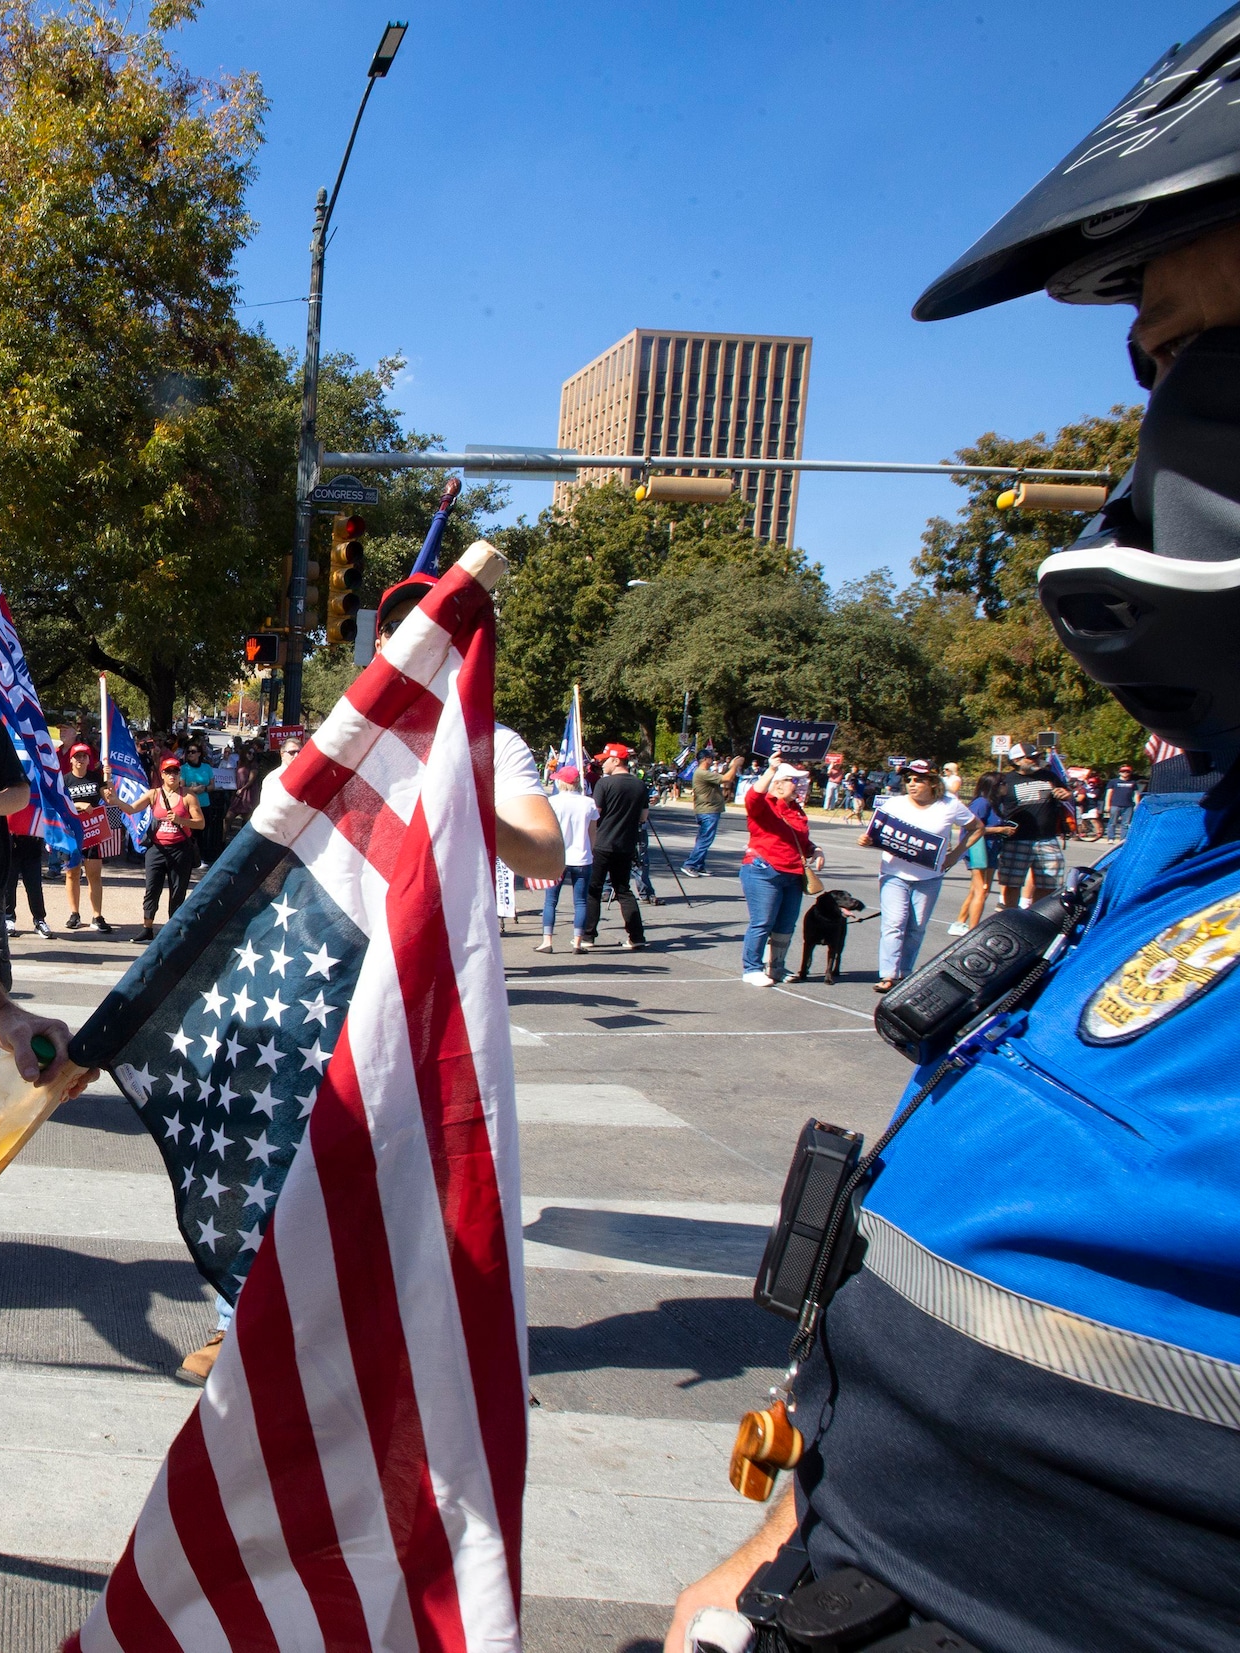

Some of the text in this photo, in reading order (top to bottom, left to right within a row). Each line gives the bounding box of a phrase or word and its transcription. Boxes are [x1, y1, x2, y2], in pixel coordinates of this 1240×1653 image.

[314, 488, 364, 500] CONGRESS
[270, 730, 303, 738] TRUMP
[760, 726, 830, 742] TRUMP
[771, 743, 810, 753] 2020
[110, 750, 137, 765] KEEP
[82, 814, 105, 828] UMP
[874, 819, 938, 851] TRUMP
[881, 839, 918, 857] 2020
